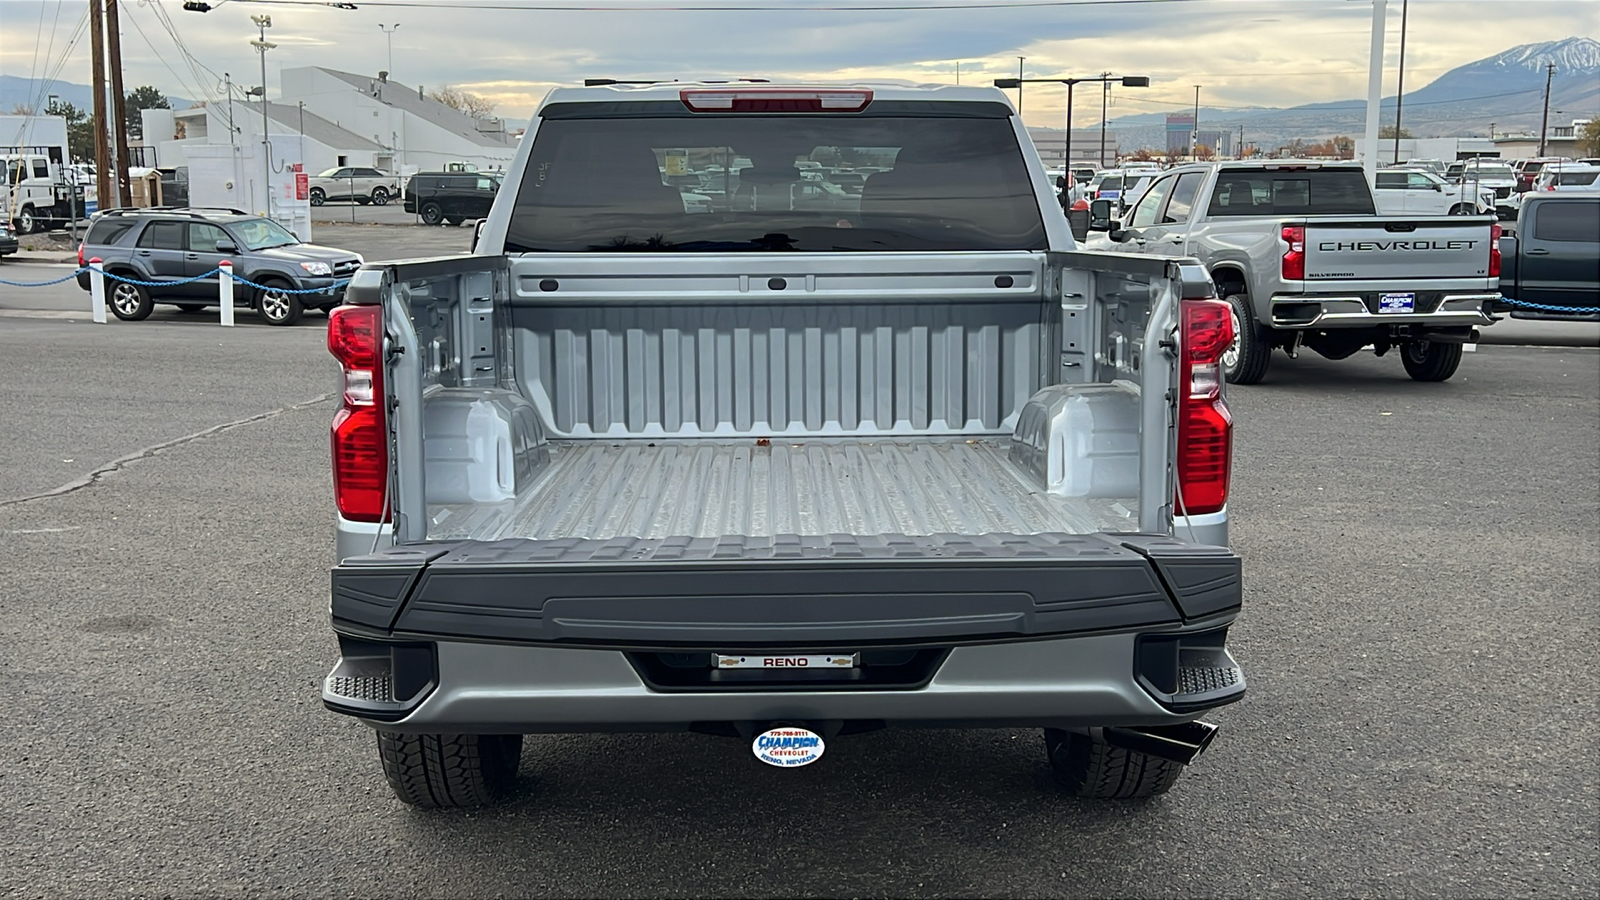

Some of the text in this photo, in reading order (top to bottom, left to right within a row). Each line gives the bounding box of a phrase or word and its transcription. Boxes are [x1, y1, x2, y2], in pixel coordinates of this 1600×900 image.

[1319, 240, 1478, 251] CHEVROLET
[763, 658, 808, 667] RENO
[758, 735, 819, 748] CHAMPION
[761, 753, 817, 765] RENO, NEVADA
